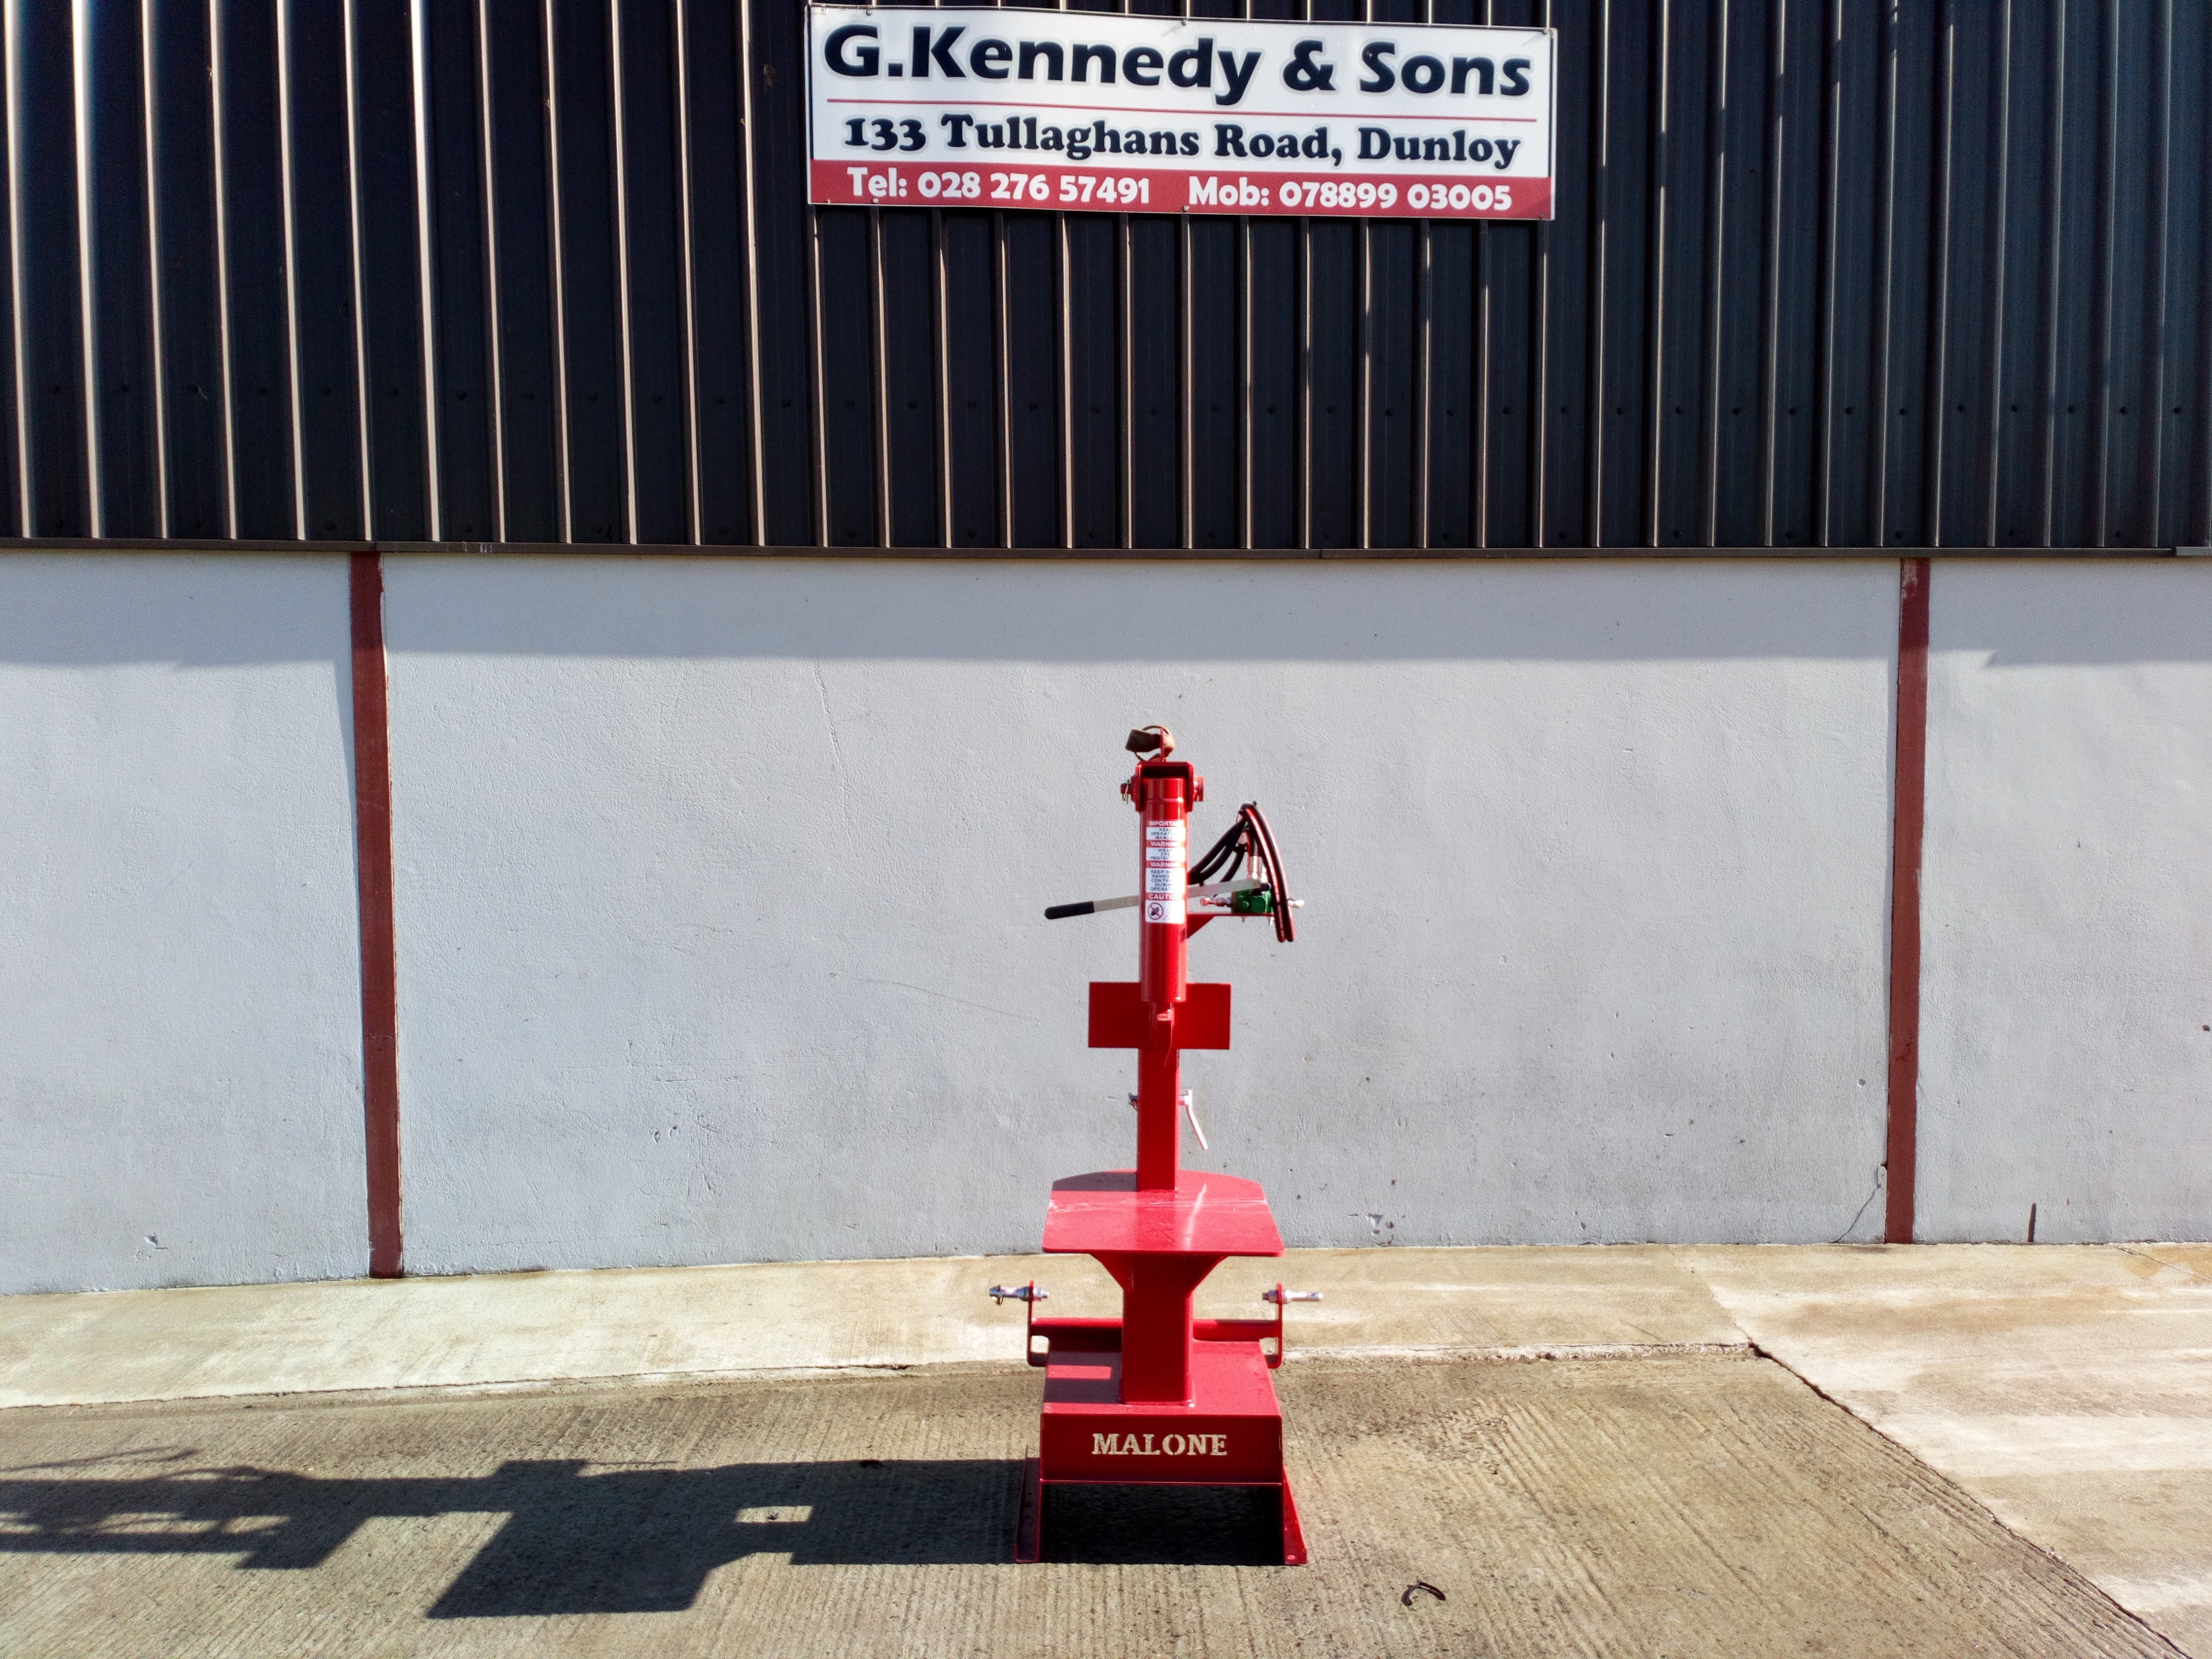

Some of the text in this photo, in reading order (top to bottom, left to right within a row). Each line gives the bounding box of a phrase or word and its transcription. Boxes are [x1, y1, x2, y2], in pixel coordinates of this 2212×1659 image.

[824, 24, 1531, 105] G.Kennedy & Sons
[845, 113, 1521, 170] 133 Tullaghans Road, Dunloy
[847, 166, 1513, 211] Tel: 028 276 57491 Mob: 078899 03005
[1091, 1433, 1228, 1456] MALONE
